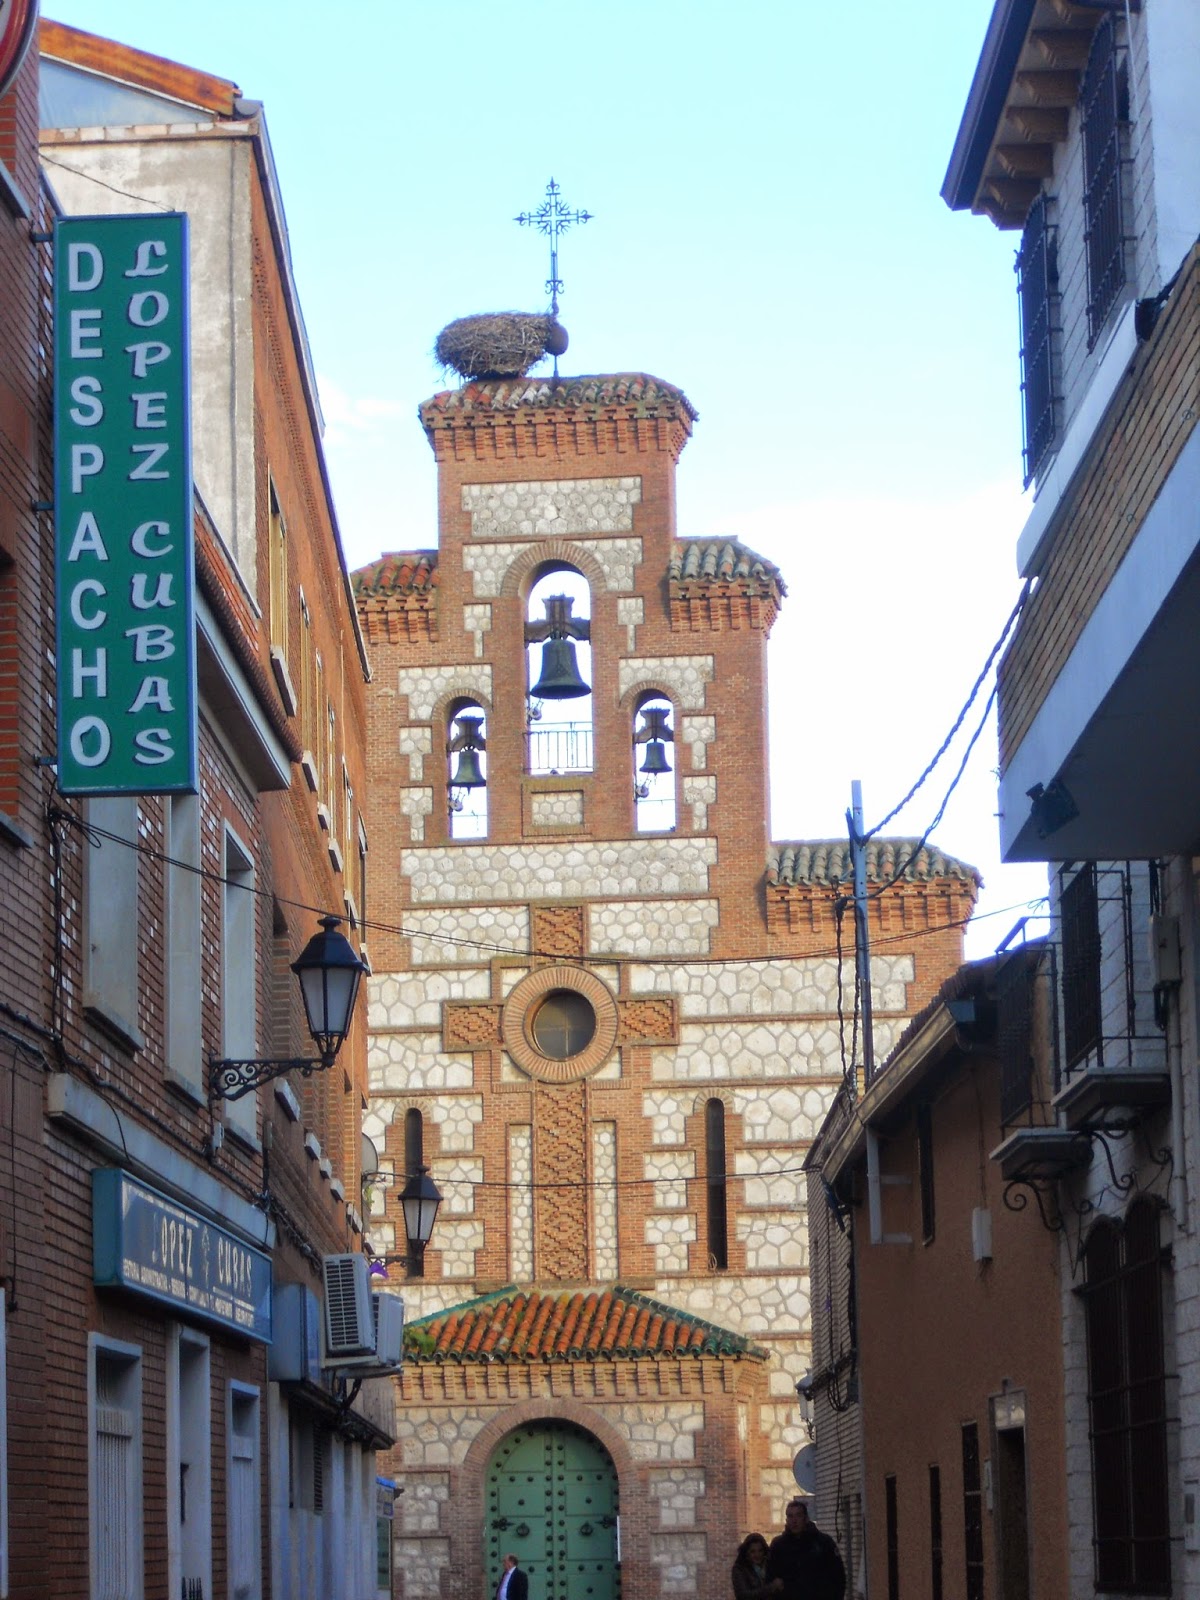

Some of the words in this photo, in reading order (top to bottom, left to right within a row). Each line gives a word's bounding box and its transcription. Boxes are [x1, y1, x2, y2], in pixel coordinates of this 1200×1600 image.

[125, 240, 171, 481] LOPEZ
[67, 242, 111, 768] DESPACHO
[125, 520, 176, 766] CUBAS
[218, 1236, 252, 1298] CUBAS
